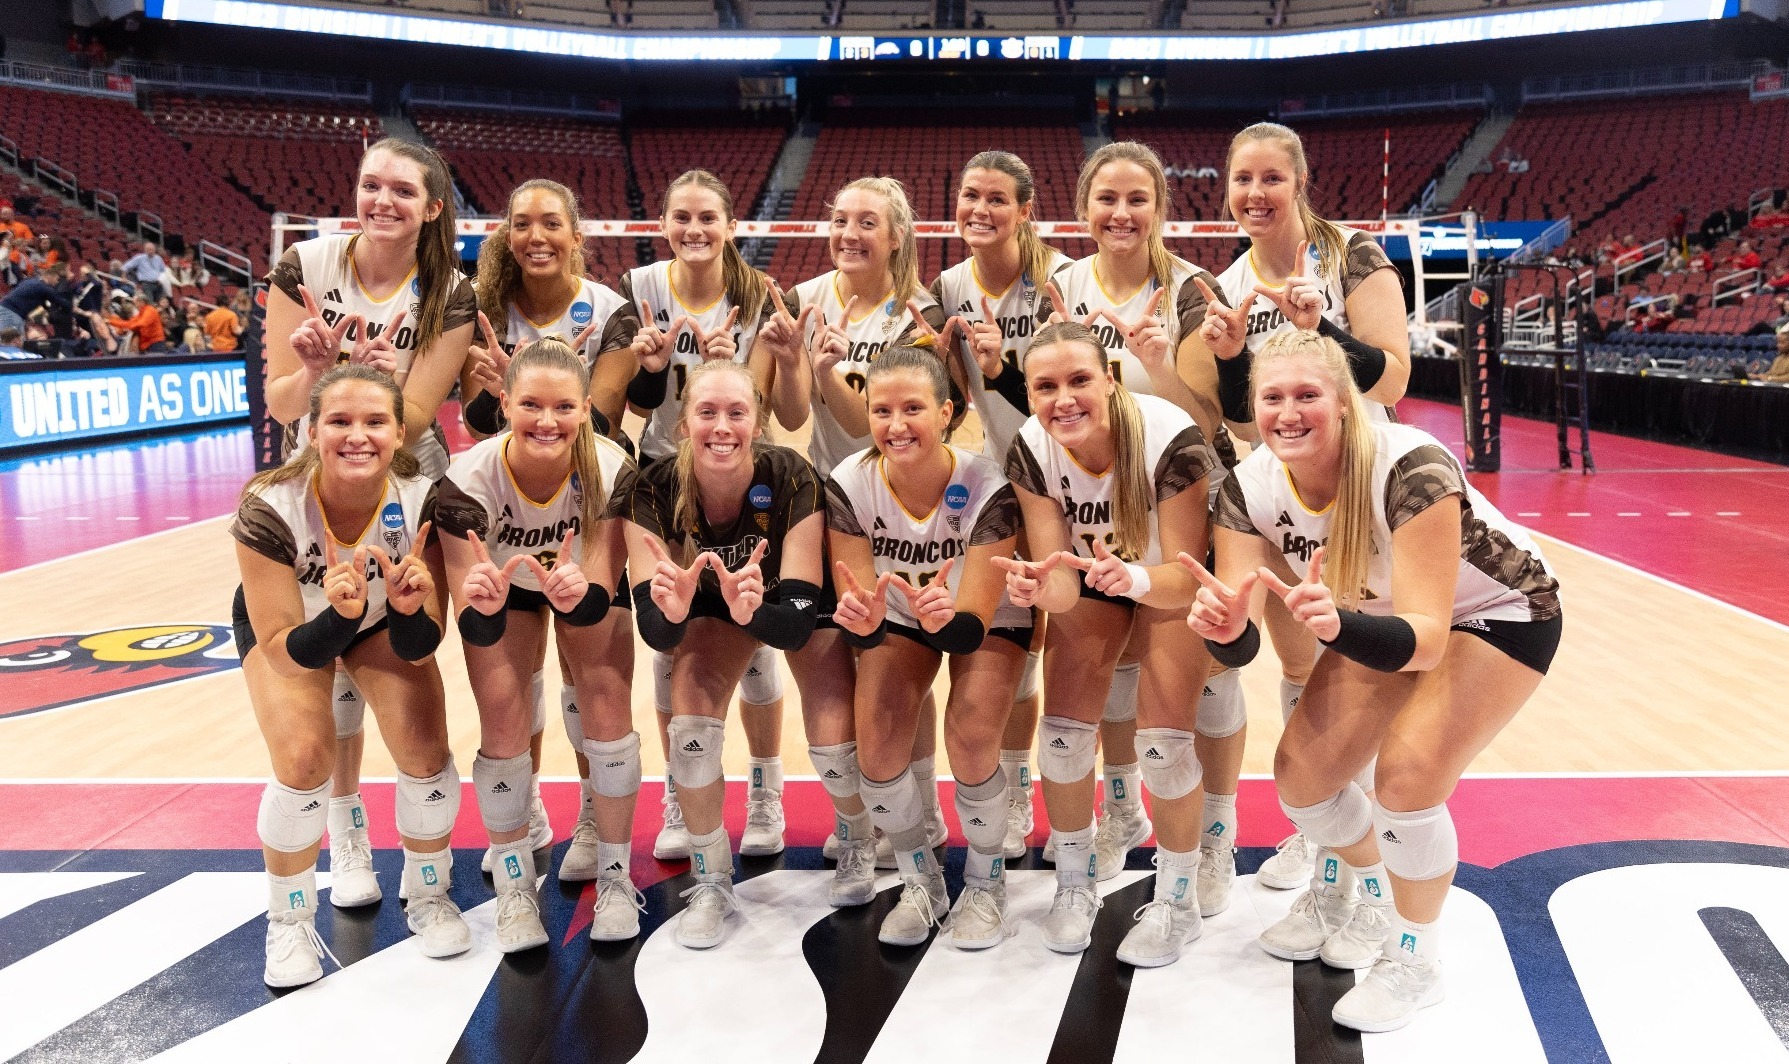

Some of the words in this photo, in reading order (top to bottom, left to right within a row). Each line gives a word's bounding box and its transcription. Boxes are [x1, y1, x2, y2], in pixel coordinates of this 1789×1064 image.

[10, 376, 130, 438] UNITED
[138, 372, 184, 423] AS
[189, 368, 250, 417] ONE
[497, 515, 582, 548] BRONCO
[873, 536, 965, 566] BRONCOS
